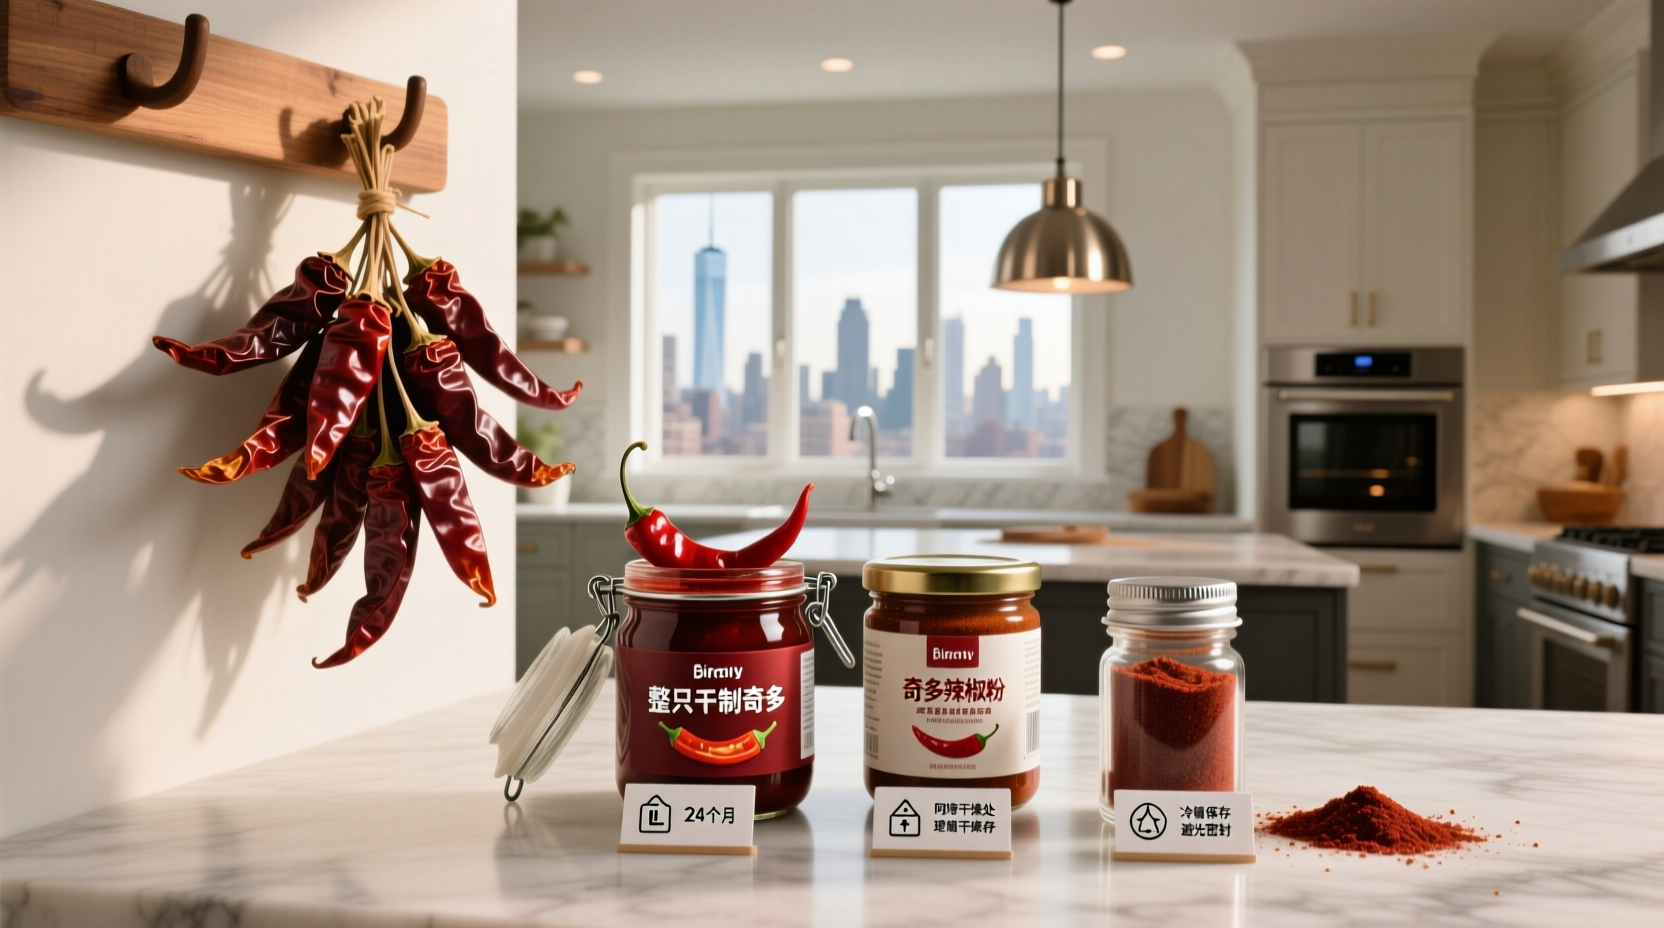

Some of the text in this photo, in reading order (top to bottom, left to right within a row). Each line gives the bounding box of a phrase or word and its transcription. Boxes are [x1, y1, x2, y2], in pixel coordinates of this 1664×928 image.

[648, 685, 785, 715] 整只干制奇多
[903, 677, 1005, 703] 奇多辣椒粉
[684, 806, 735, 824] 24个月
